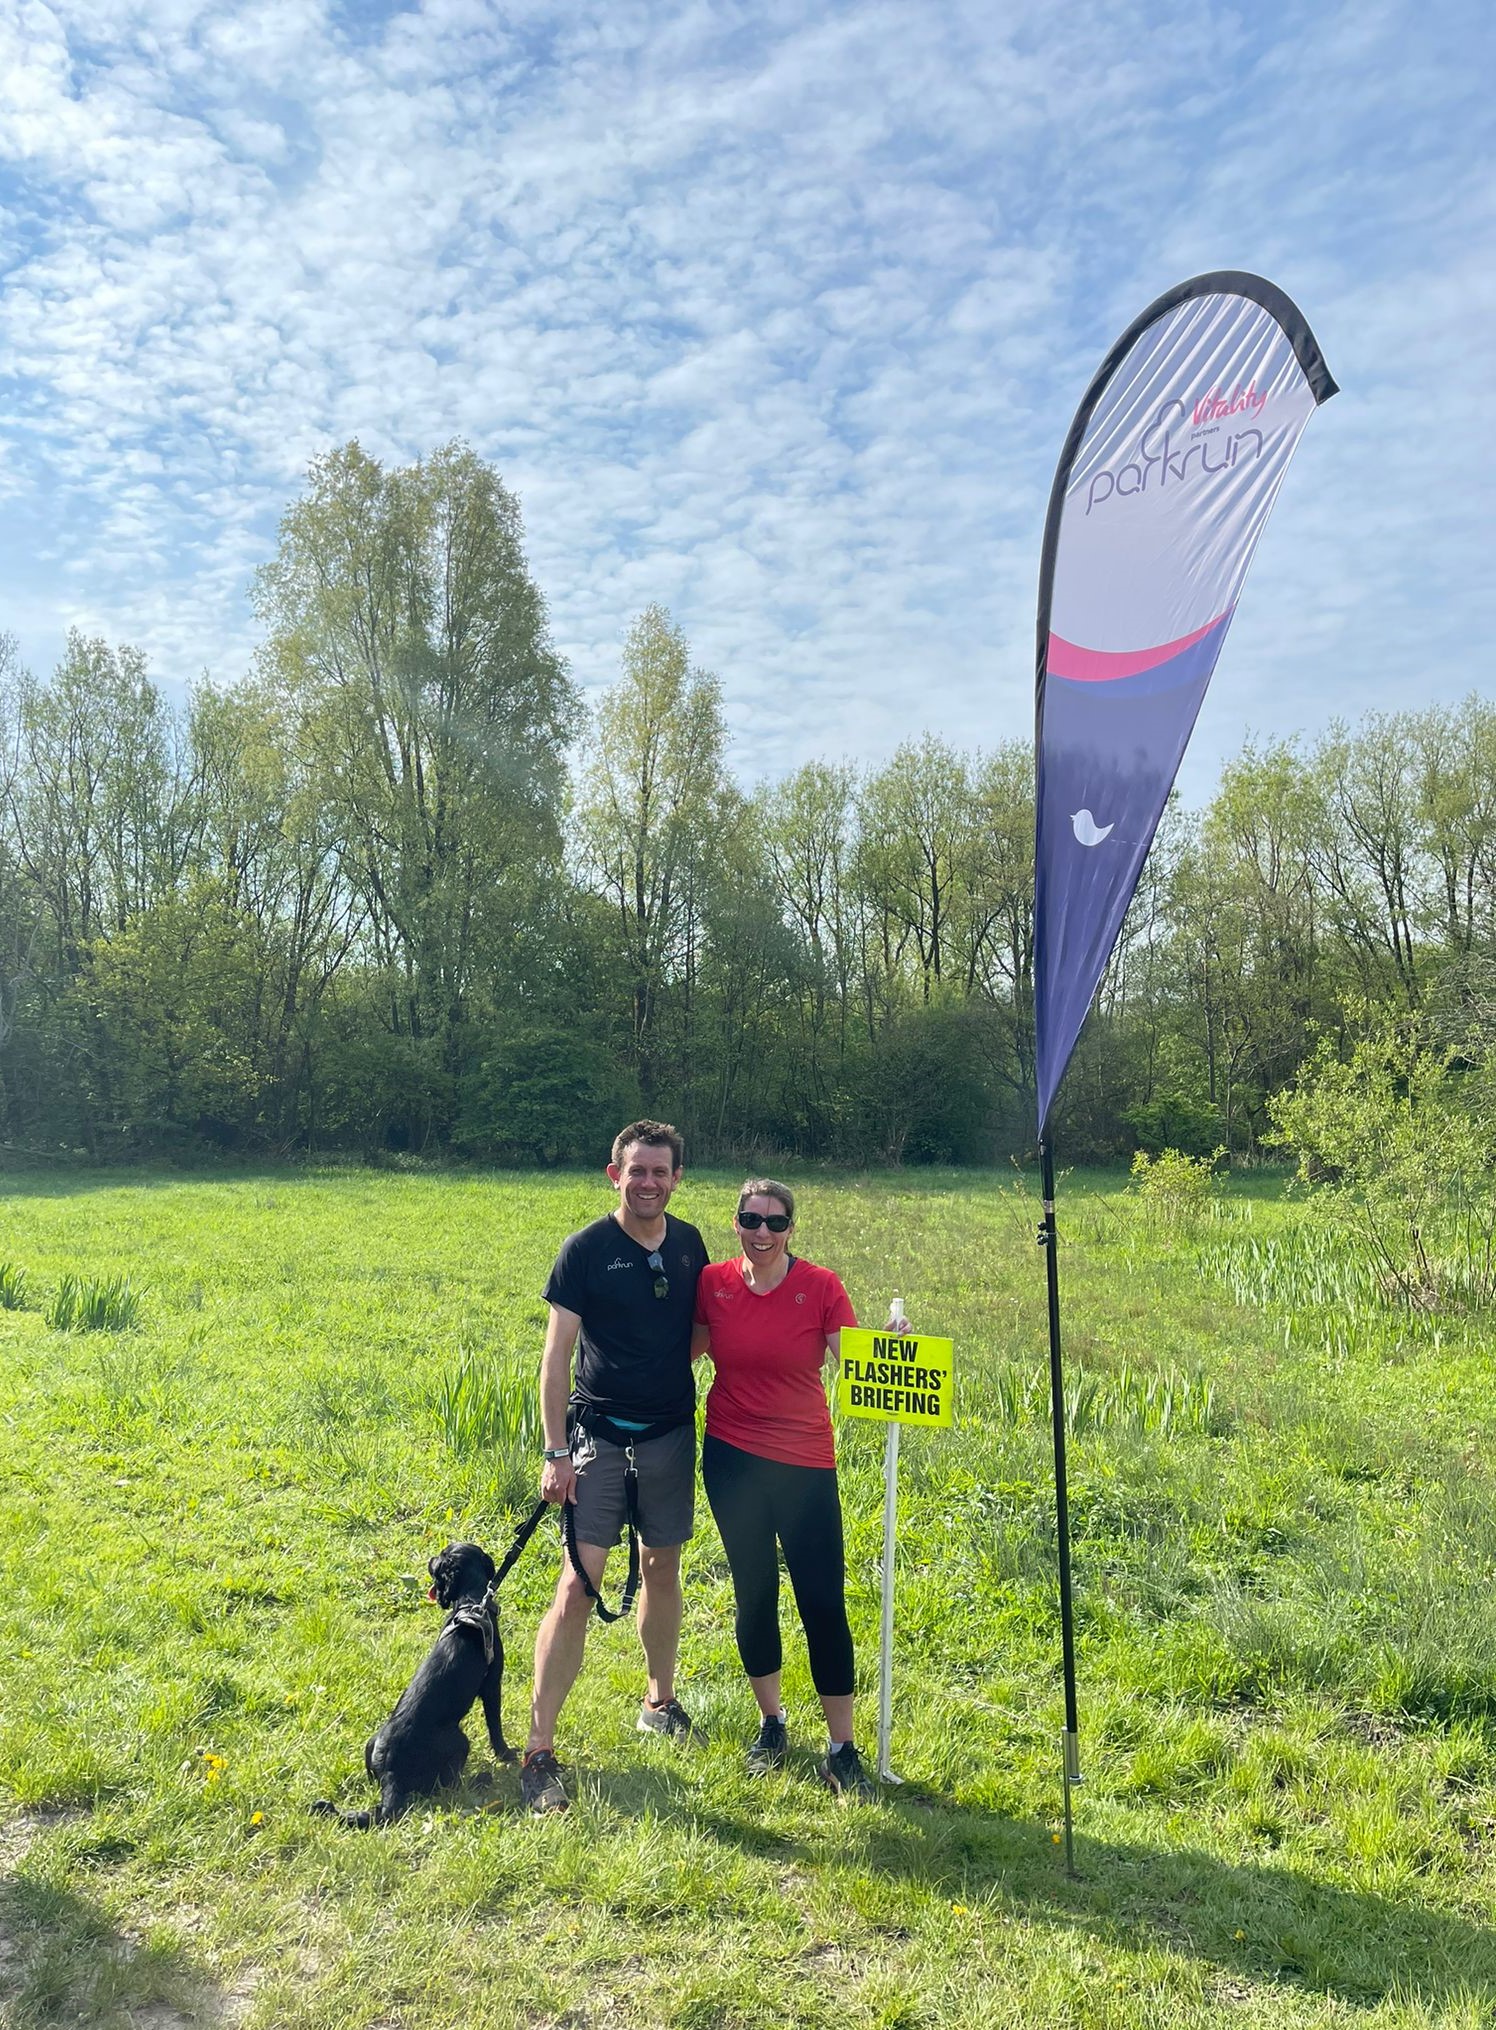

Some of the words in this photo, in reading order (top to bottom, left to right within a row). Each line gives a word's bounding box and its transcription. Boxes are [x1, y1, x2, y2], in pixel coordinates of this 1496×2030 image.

[1192, 380, 1267, 426] Vitality
[1085, 399, 1264, 516] parkrun
[607, 1257, 634, 1271] parkrun
[873, 1337, 918, 1362] NEW
[844, 1359, 947, 1390] FLASHERS'
[850, 1385, 940, 1416] BRIEFING
